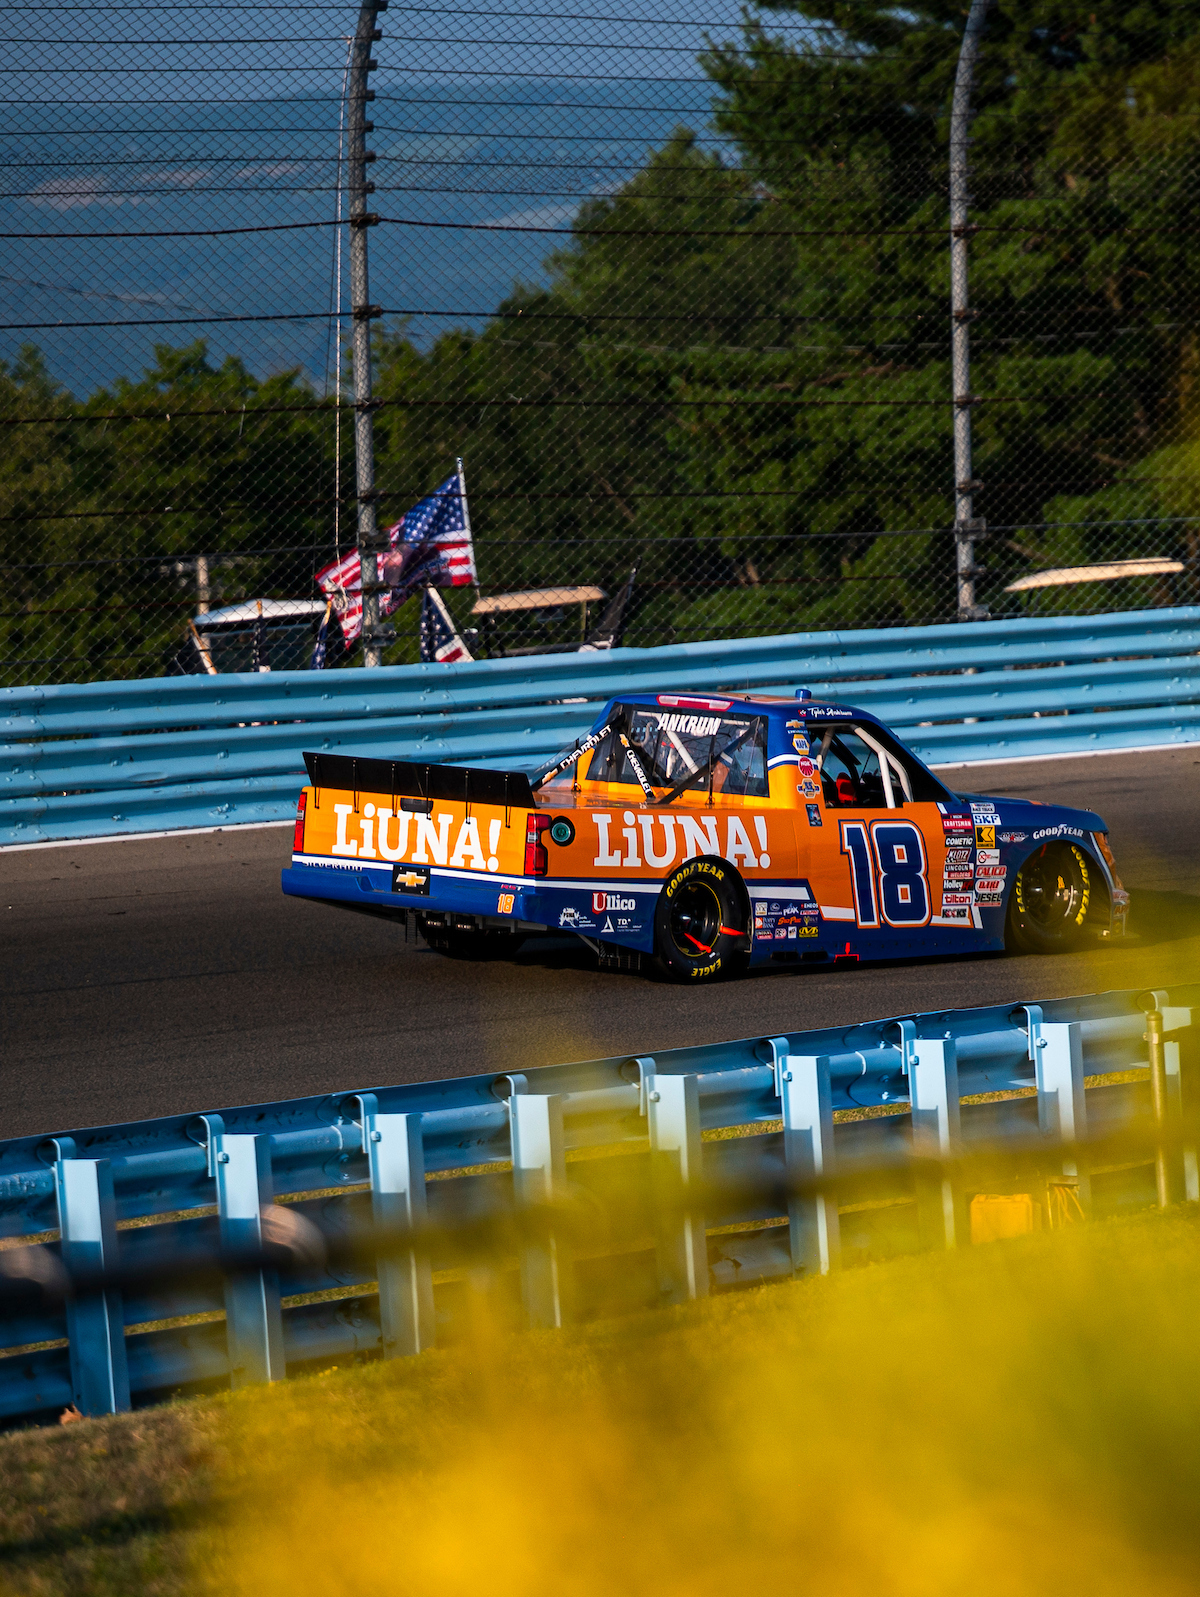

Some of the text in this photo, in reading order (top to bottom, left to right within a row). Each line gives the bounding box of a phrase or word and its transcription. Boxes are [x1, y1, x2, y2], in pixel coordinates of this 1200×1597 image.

[657, 713, 722, 736] ANKRUM
[559, 724, 612, 768] CHEVROLET
[795, 740, 808, 748] NAPA
[626, 749, 652, 794] CHEVROLET
[974, 815, 999, 824] SKF
[332, 802, 502, 872] LiUNA!
[592, 810, 771, 869] LiUNA!
[946, 838, 973, 846] COMETIC
[948, 849, 969, 860] KLOTZ
[666, 862, 725, 898] GOODYEAR
[838, 819, 932, 930] 18
[977, 867, 1006, 876] CALICO
[943, 879, 963, 891] Holley
[497, 893, 515, 914] 18
[592, 892, 636, 911] Ullico
[945, 895, 970, 904] tilton
[974, 893, 1001, 903] JESEL
[783, 906, 799, 916] PEAK
[691, 958, 722, 977] EAGLE
